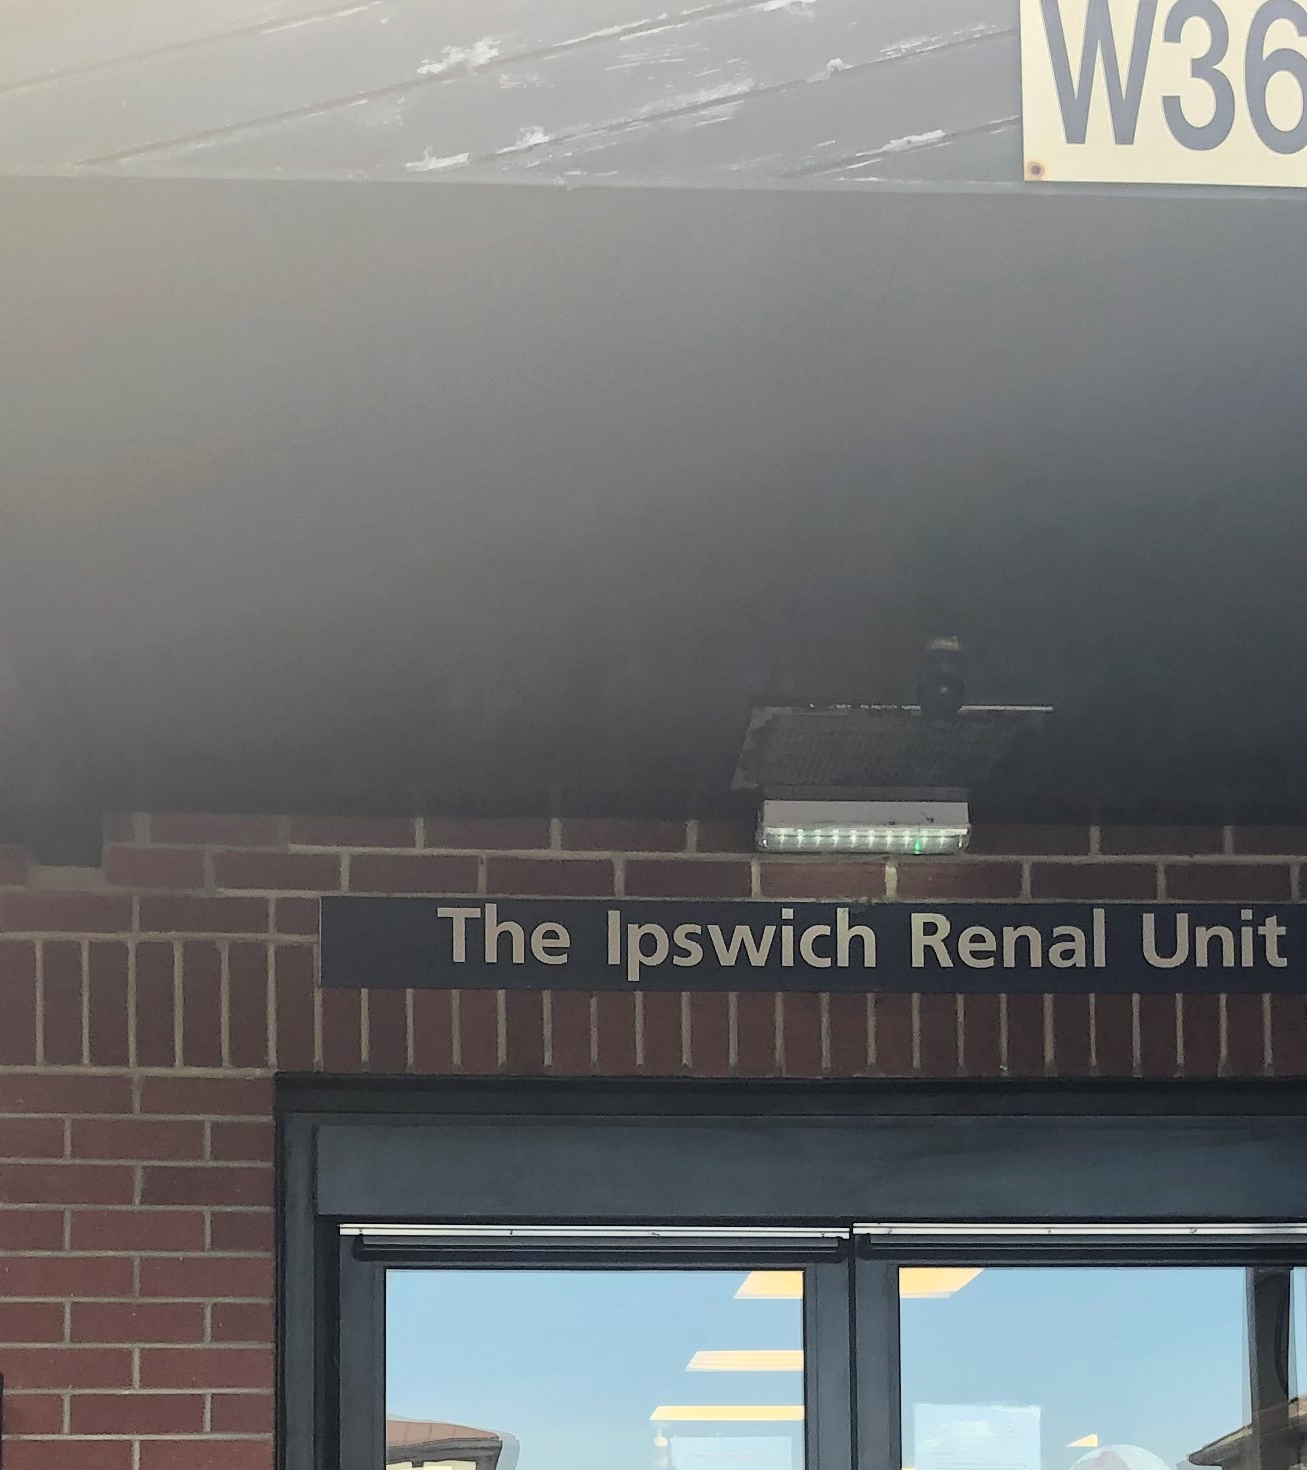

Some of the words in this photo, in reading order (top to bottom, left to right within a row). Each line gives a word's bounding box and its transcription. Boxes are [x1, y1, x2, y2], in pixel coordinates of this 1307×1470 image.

[437, 903, 572, 966] The
[606, 906, 877, 982] Ipswich
[909, 907, 1106, 969] Renal
[1141, 908, 1289, 969] Unit
